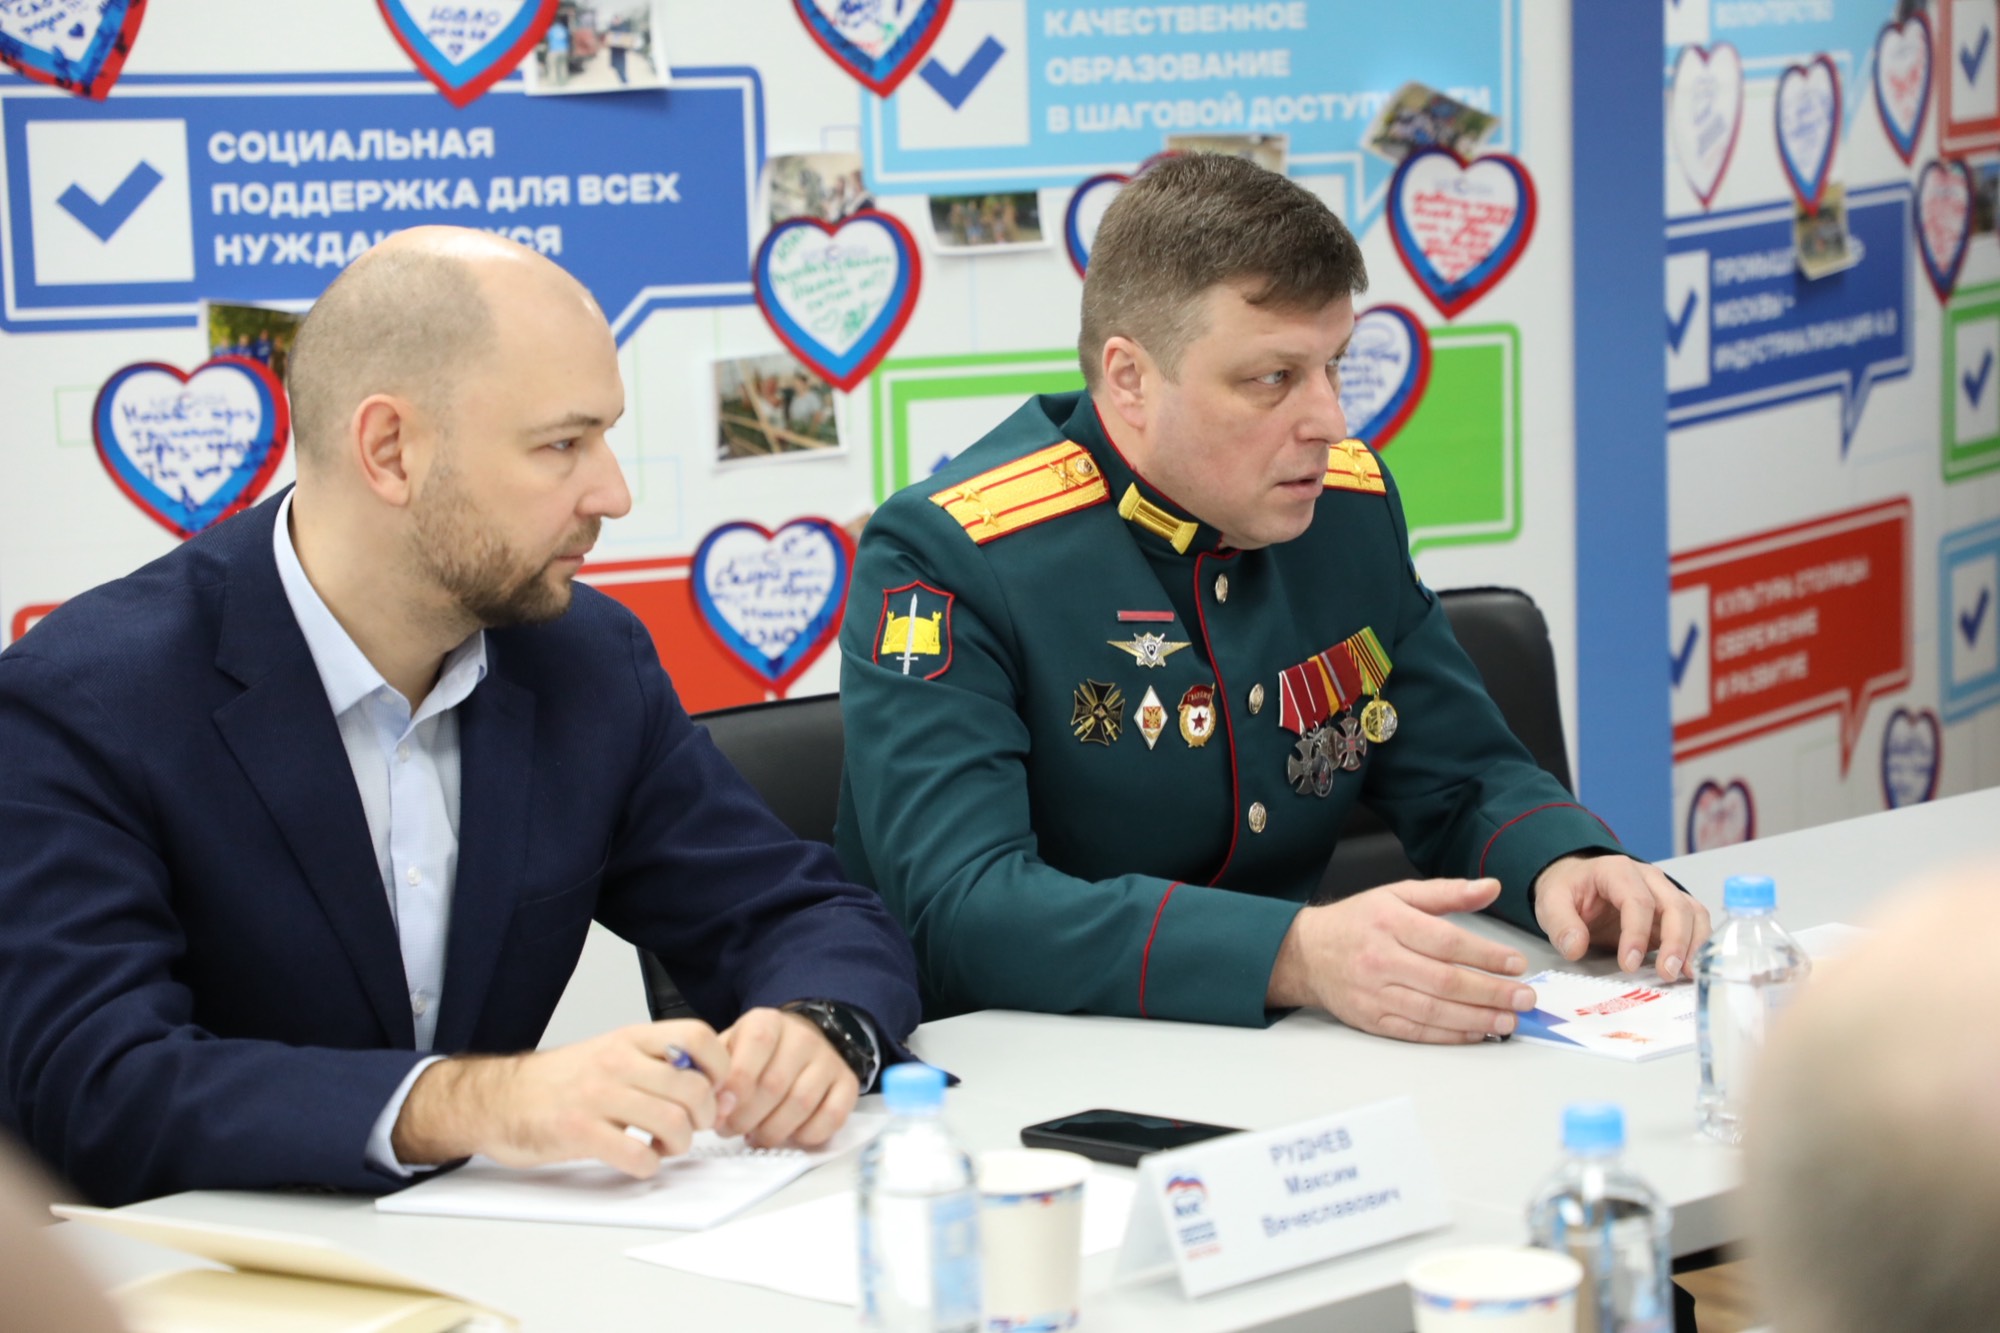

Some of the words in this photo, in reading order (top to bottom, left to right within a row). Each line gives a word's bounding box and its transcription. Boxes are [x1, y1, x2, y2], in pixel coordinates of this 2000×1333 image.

[1044, 2, 1308, 37] КАЧЕСТВЕННОЕ
[1045, 49, 1292, 85] ОБРАЗОВАНИЕ
[1047, 105, 1071, 133] В
[1074, 91, 1245, 131] ШАГОВОЙ
[207, 127, 496, 168] СОЦИАЛЬНАЯ
[211, 177, 481, 219] ПОДДЕРЖКА
[487, 175, 571, 214] ДЛЯ
[577, 171, 681, 206] ВСЕХ
[214, 225, 563, 269] НУЖДАСЯ
[1269, 1127, 1352, 1166] РУДНЕВ
[1284, 1166, 1358, 1196] Максим
